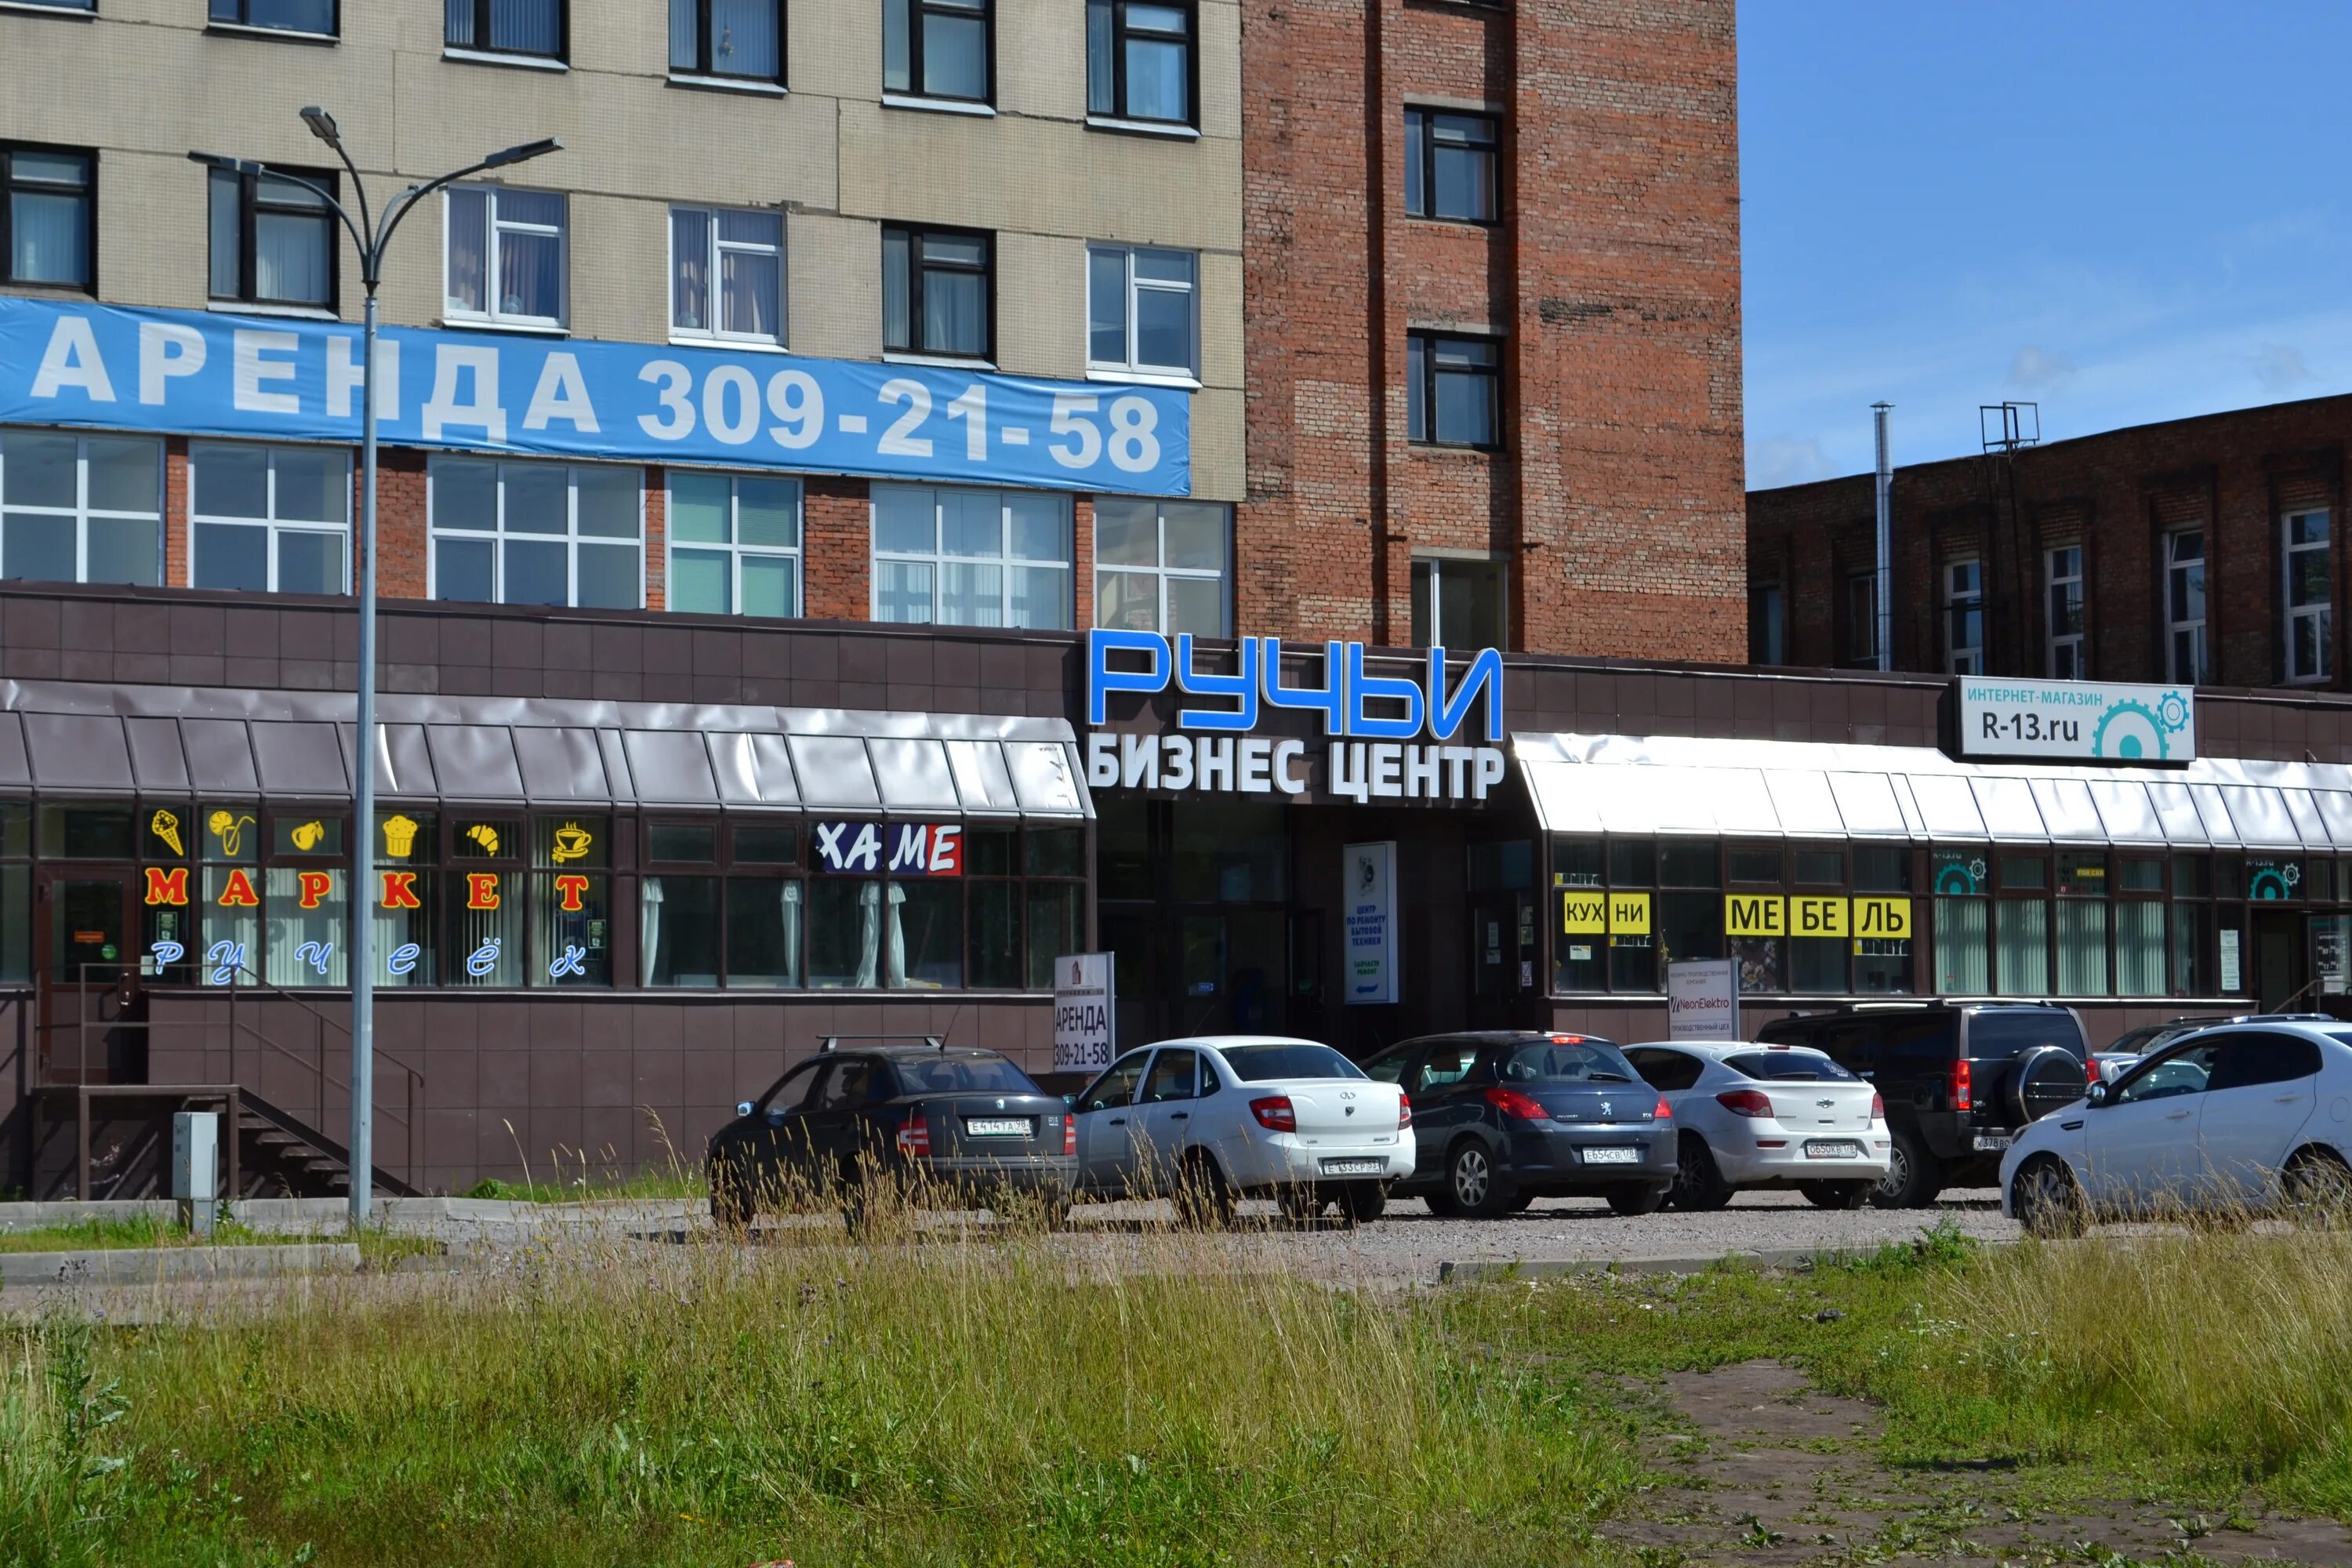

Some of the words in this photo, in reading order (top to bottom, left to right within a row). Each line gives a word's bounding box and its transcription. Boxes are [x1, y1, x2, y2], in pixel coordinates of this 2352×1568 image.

[30, 315, 601, 443] АРЕНДА
[637, 358, 1161, 473] 309-21-58
[1086, 628, 1504, 742] РУЧЬИ
[1968, 688, 2103, 706] ИНТЕРНЕТ-МАГАЗИН
[1982, 712, 2079, 742] R-13.ru
[1088, 732, 1305, 793] БИЗНЕС
[1328, 741, 1505, 804] ЦЕНТР
[144, 867, 589, 911] МАРКЕТ
[1055, 1005, 1107, 1036] АРЕНДА
[1054, 1042, 1109, 1066] 309-21-58
